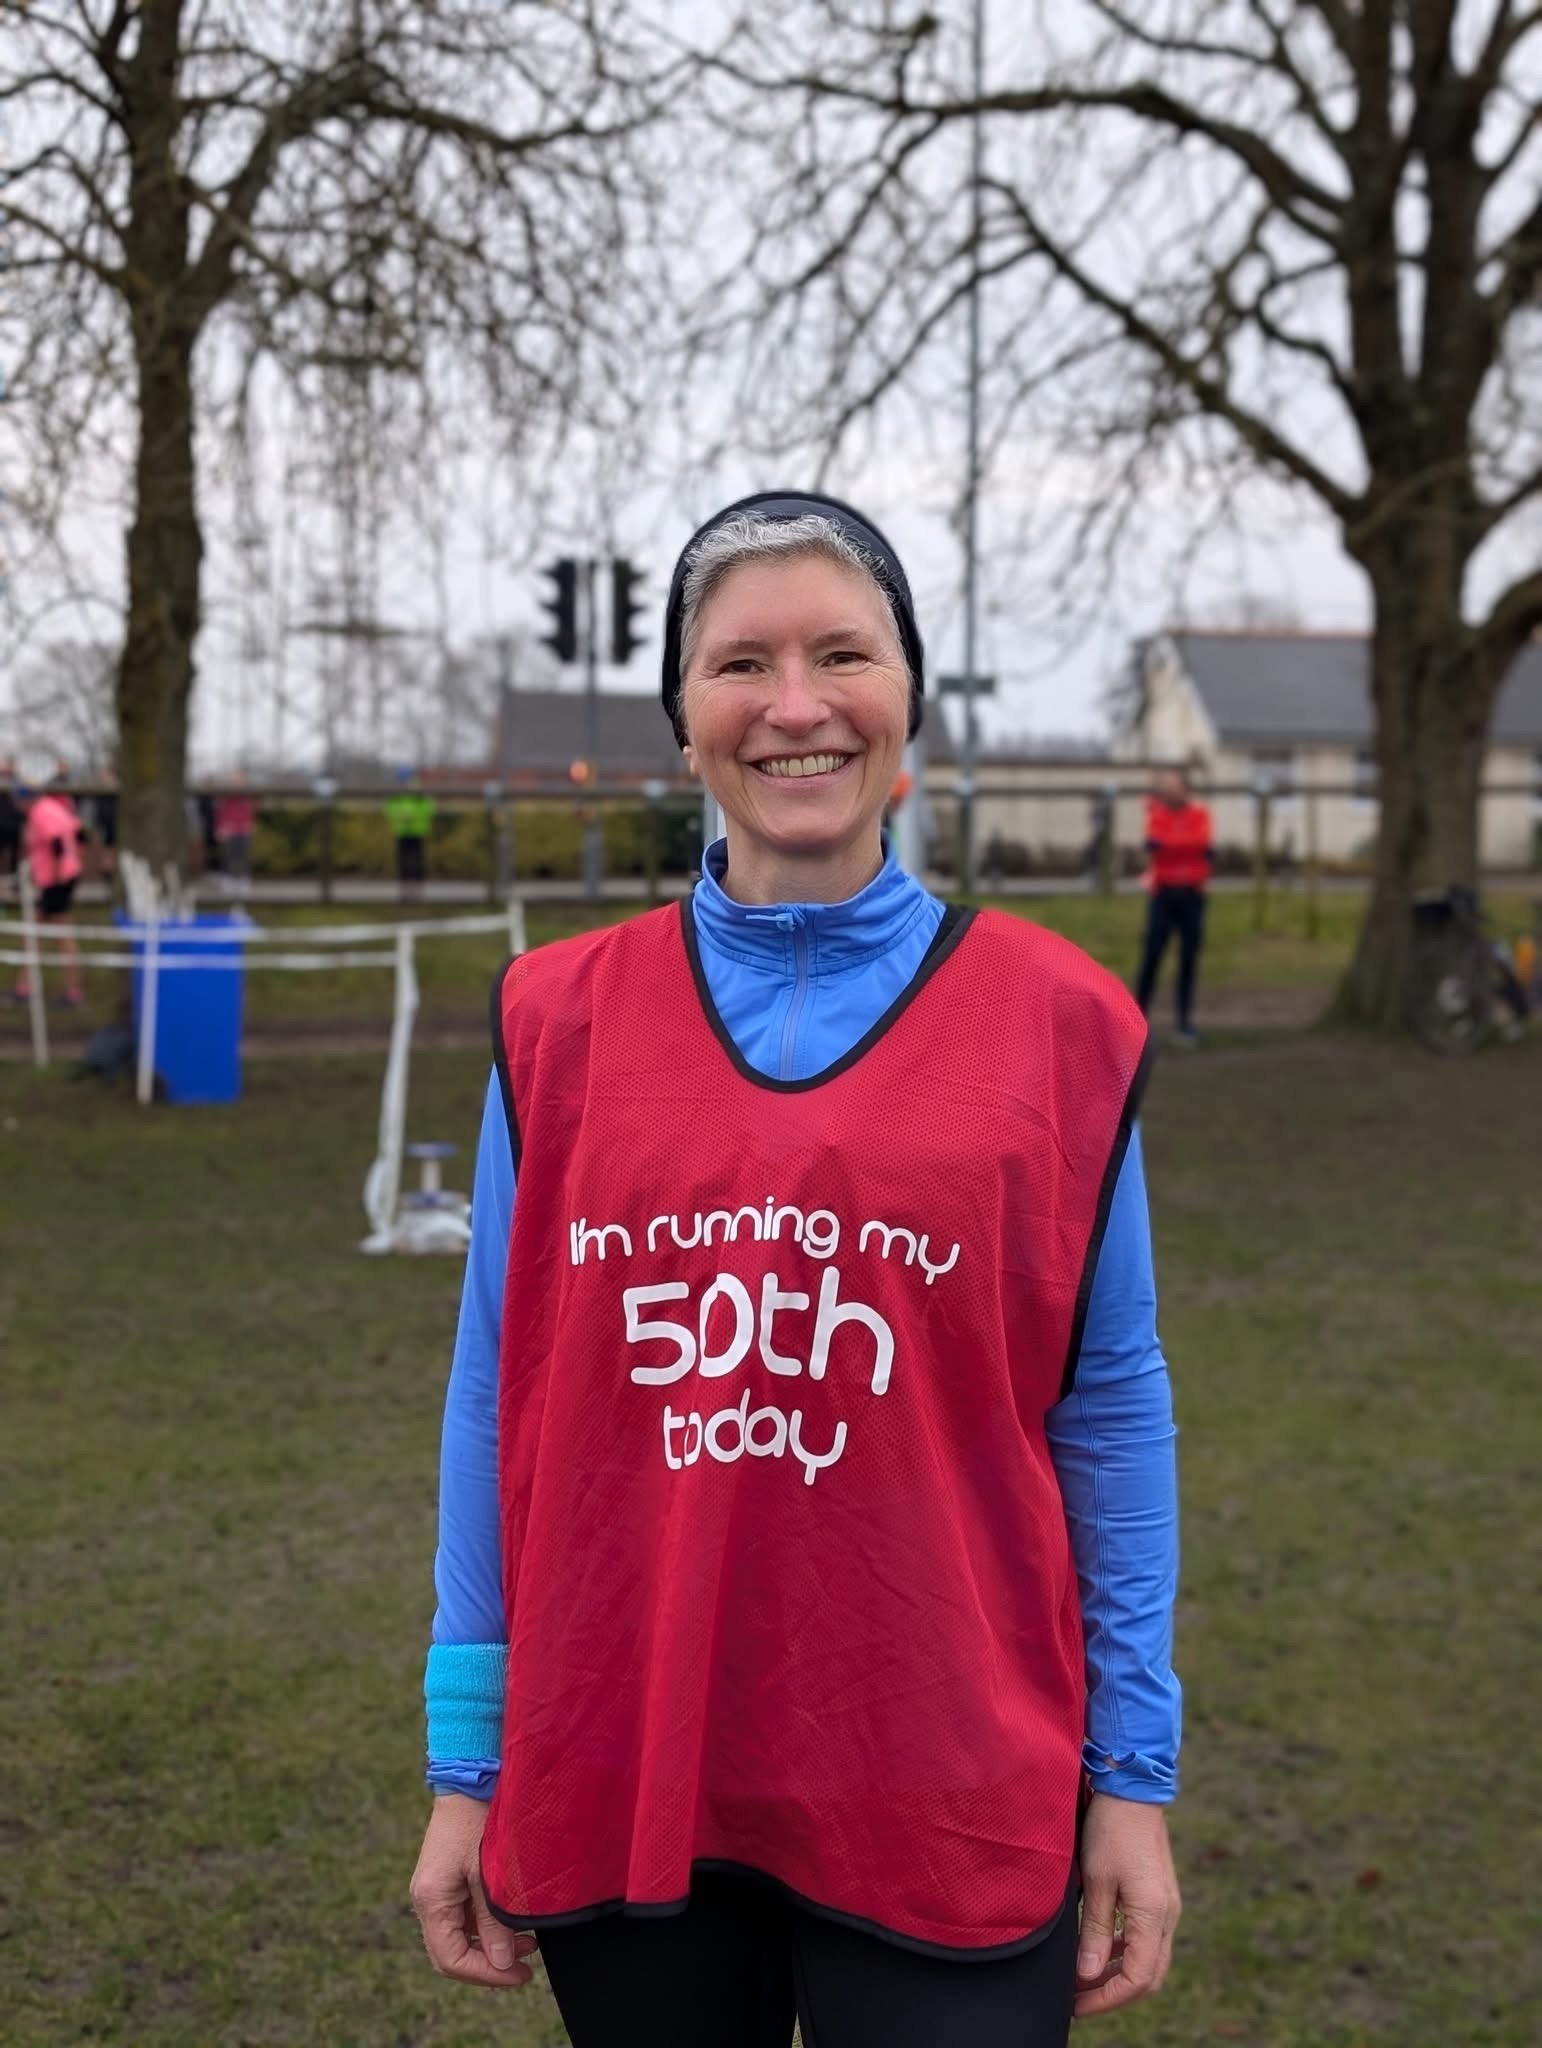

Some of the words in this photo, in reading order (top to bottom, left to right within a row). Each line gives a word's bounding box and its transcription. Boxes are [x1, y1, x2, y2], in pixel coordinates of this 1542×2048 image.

[570, 1217, 632, 1266] I'm
[647, 1195, 841, 1259] running
[859, 1220, 961, 1286] my
[622, 1265, 895, 1396] 50th
[663, 1388, 848, 1486] today
